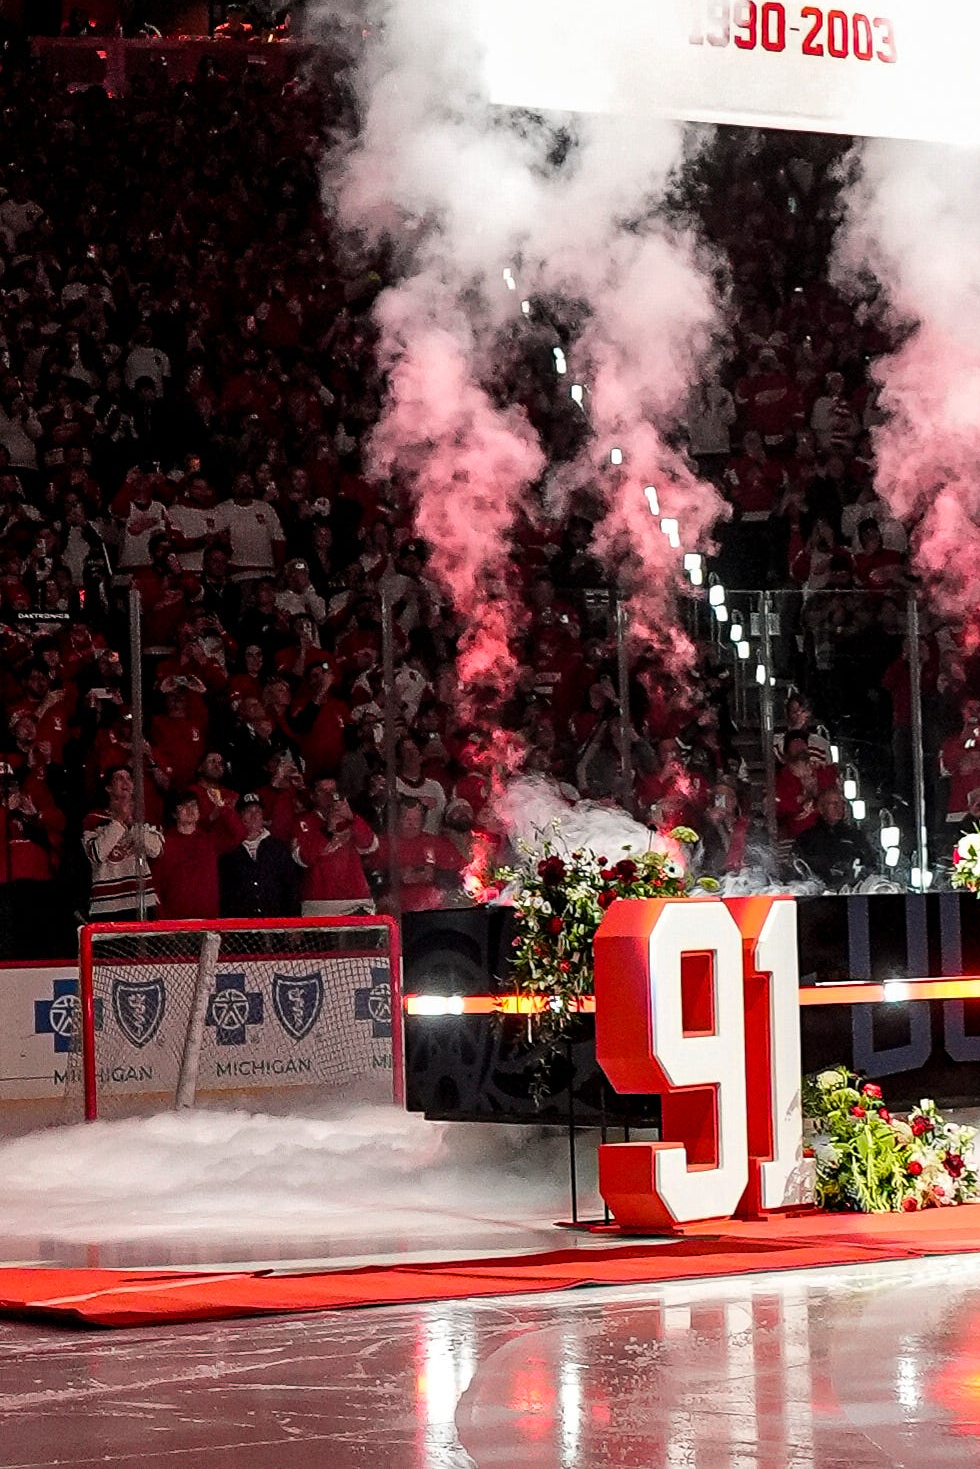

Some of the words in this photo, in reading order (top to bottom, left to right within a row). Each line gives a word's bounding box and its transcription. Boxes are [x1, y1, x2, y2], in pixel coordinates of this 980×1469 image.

[689, 0, 898, 64] 990-2003
[54, 1066, 153, 1085] MIHIGAN
[216, 1058, 311, 1077] MICHIGAN
[620, 896, 816, 1224] 91
